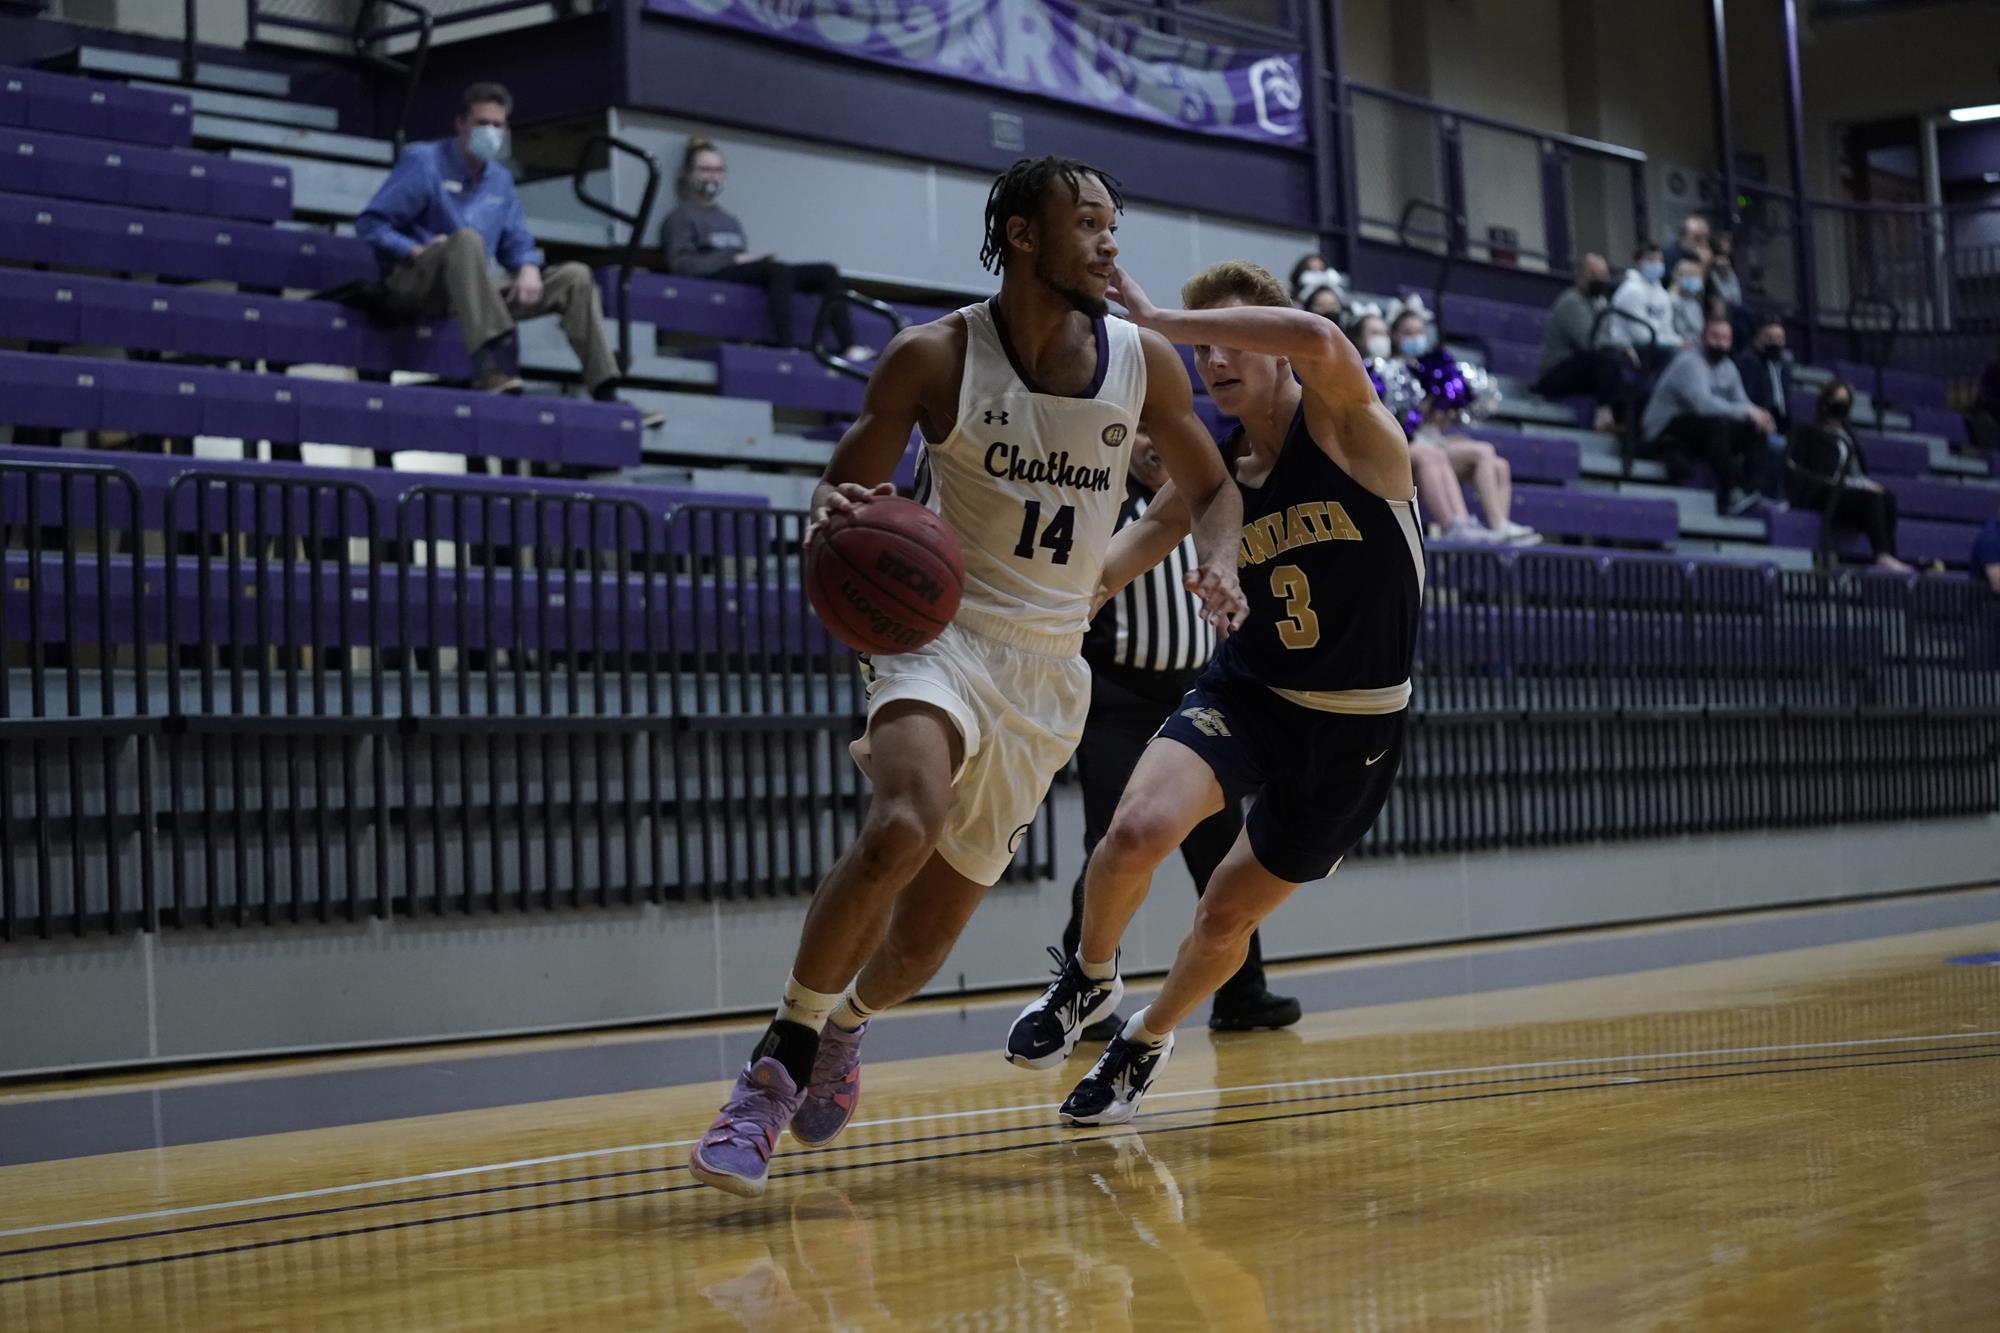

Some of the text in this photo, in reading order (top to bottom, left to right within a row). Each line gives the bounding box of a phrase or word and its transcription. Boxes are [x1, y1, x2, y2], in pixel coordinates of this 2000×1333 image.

[984, 441, 1110, 491] Chatham
[1013, 499, 1075, 565] 14
[1237, 500, 1364, 569] NIATA
[876, 549, 944, 605] NCAA
[1269, 563, 1321, 650] 3
[841, 580, 927, 647] Wilson
